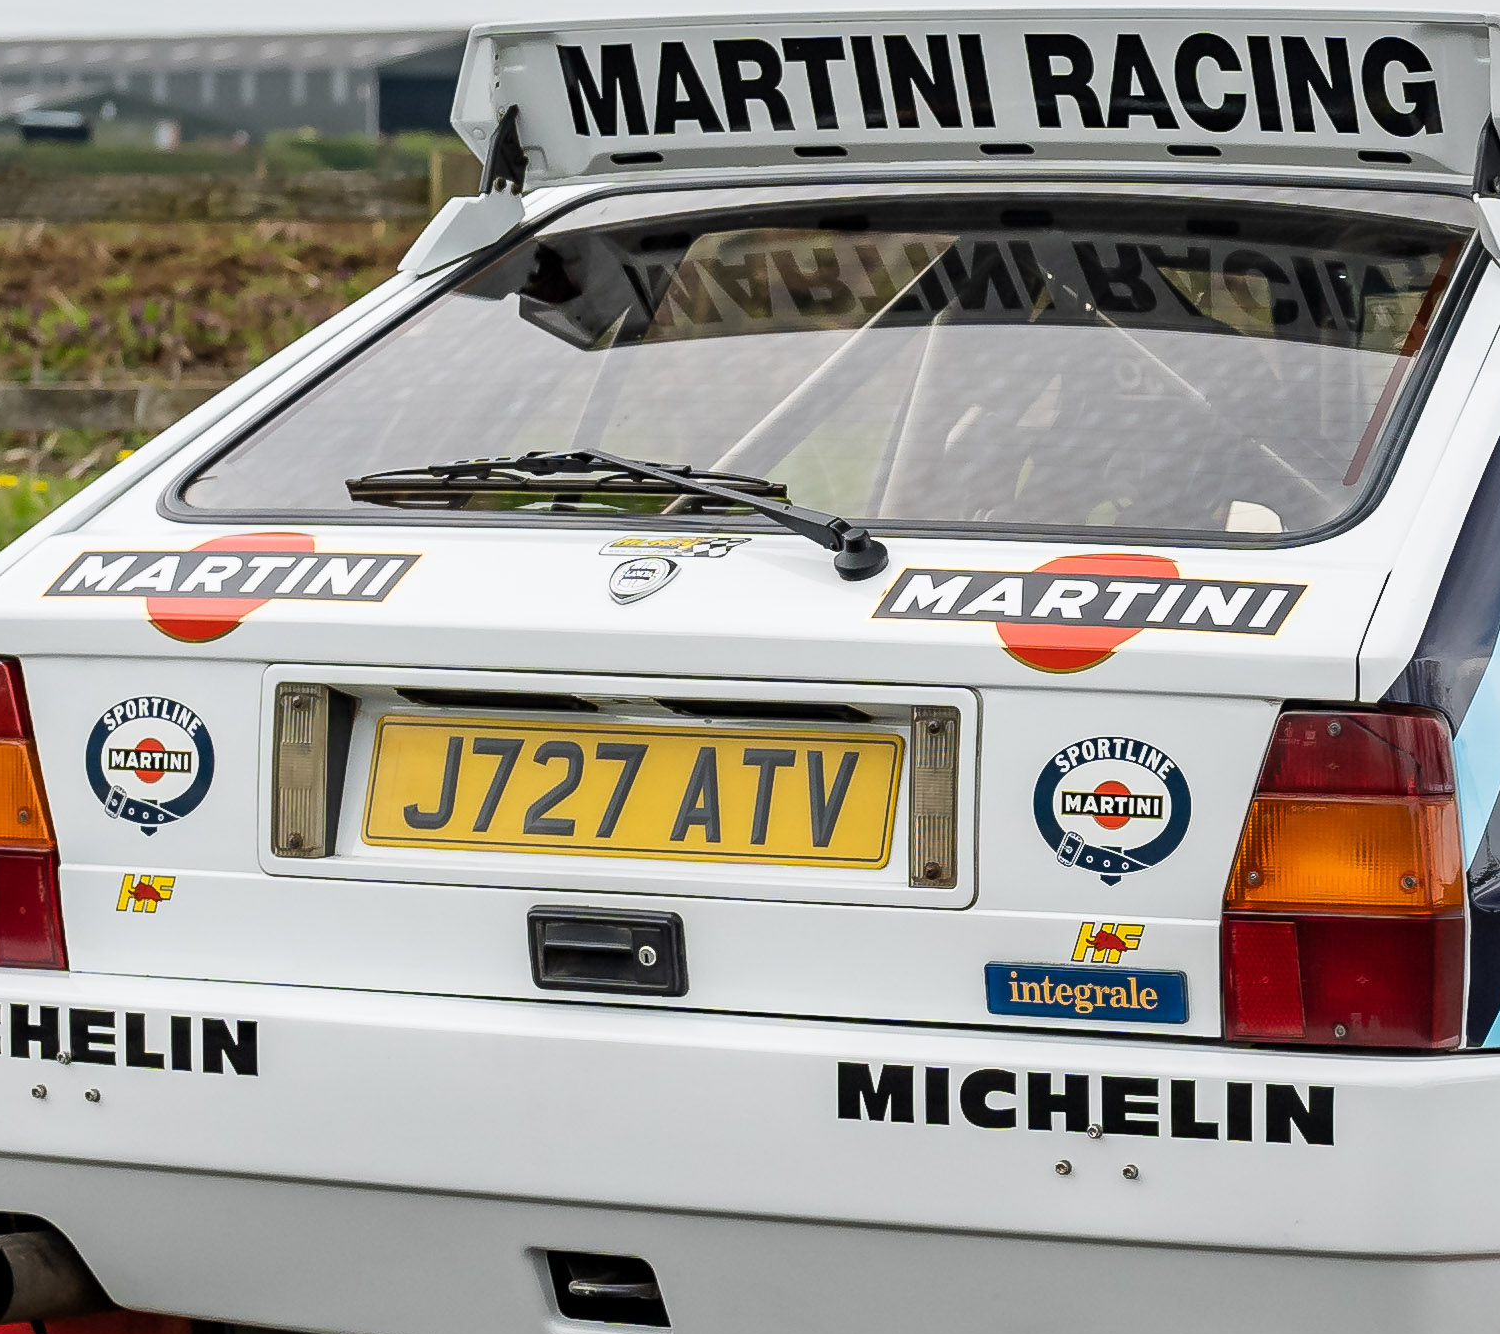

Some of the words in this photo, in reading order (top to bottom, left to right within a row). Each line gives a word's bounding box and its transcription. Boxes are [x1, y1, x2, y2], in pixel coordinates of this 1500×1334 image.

[556, 33, 997, 137] MARTINI
[1023, 33, 1443, 138] RACING
[59, 553, 405, 599] MARTINI
[890, 577, 1292, 631] MARTINI
[102, 697, 203, 737] SPORTLINE
[109, 748, 192, 773] MARTINI
[1054, 736, 1175, 782] SPORTLINE
[403, 735, 649, 838] J727
[669, 746, 859, 848] ATV
[1063, 792, 1161, 818] MARTINI
[116, 873, 176, 914] HF
[1072, 921, 1144, 964] HF
[1009, 971, 1158, 1015] integrale
[837, 1061, 1334, 1147] MICHELIN
